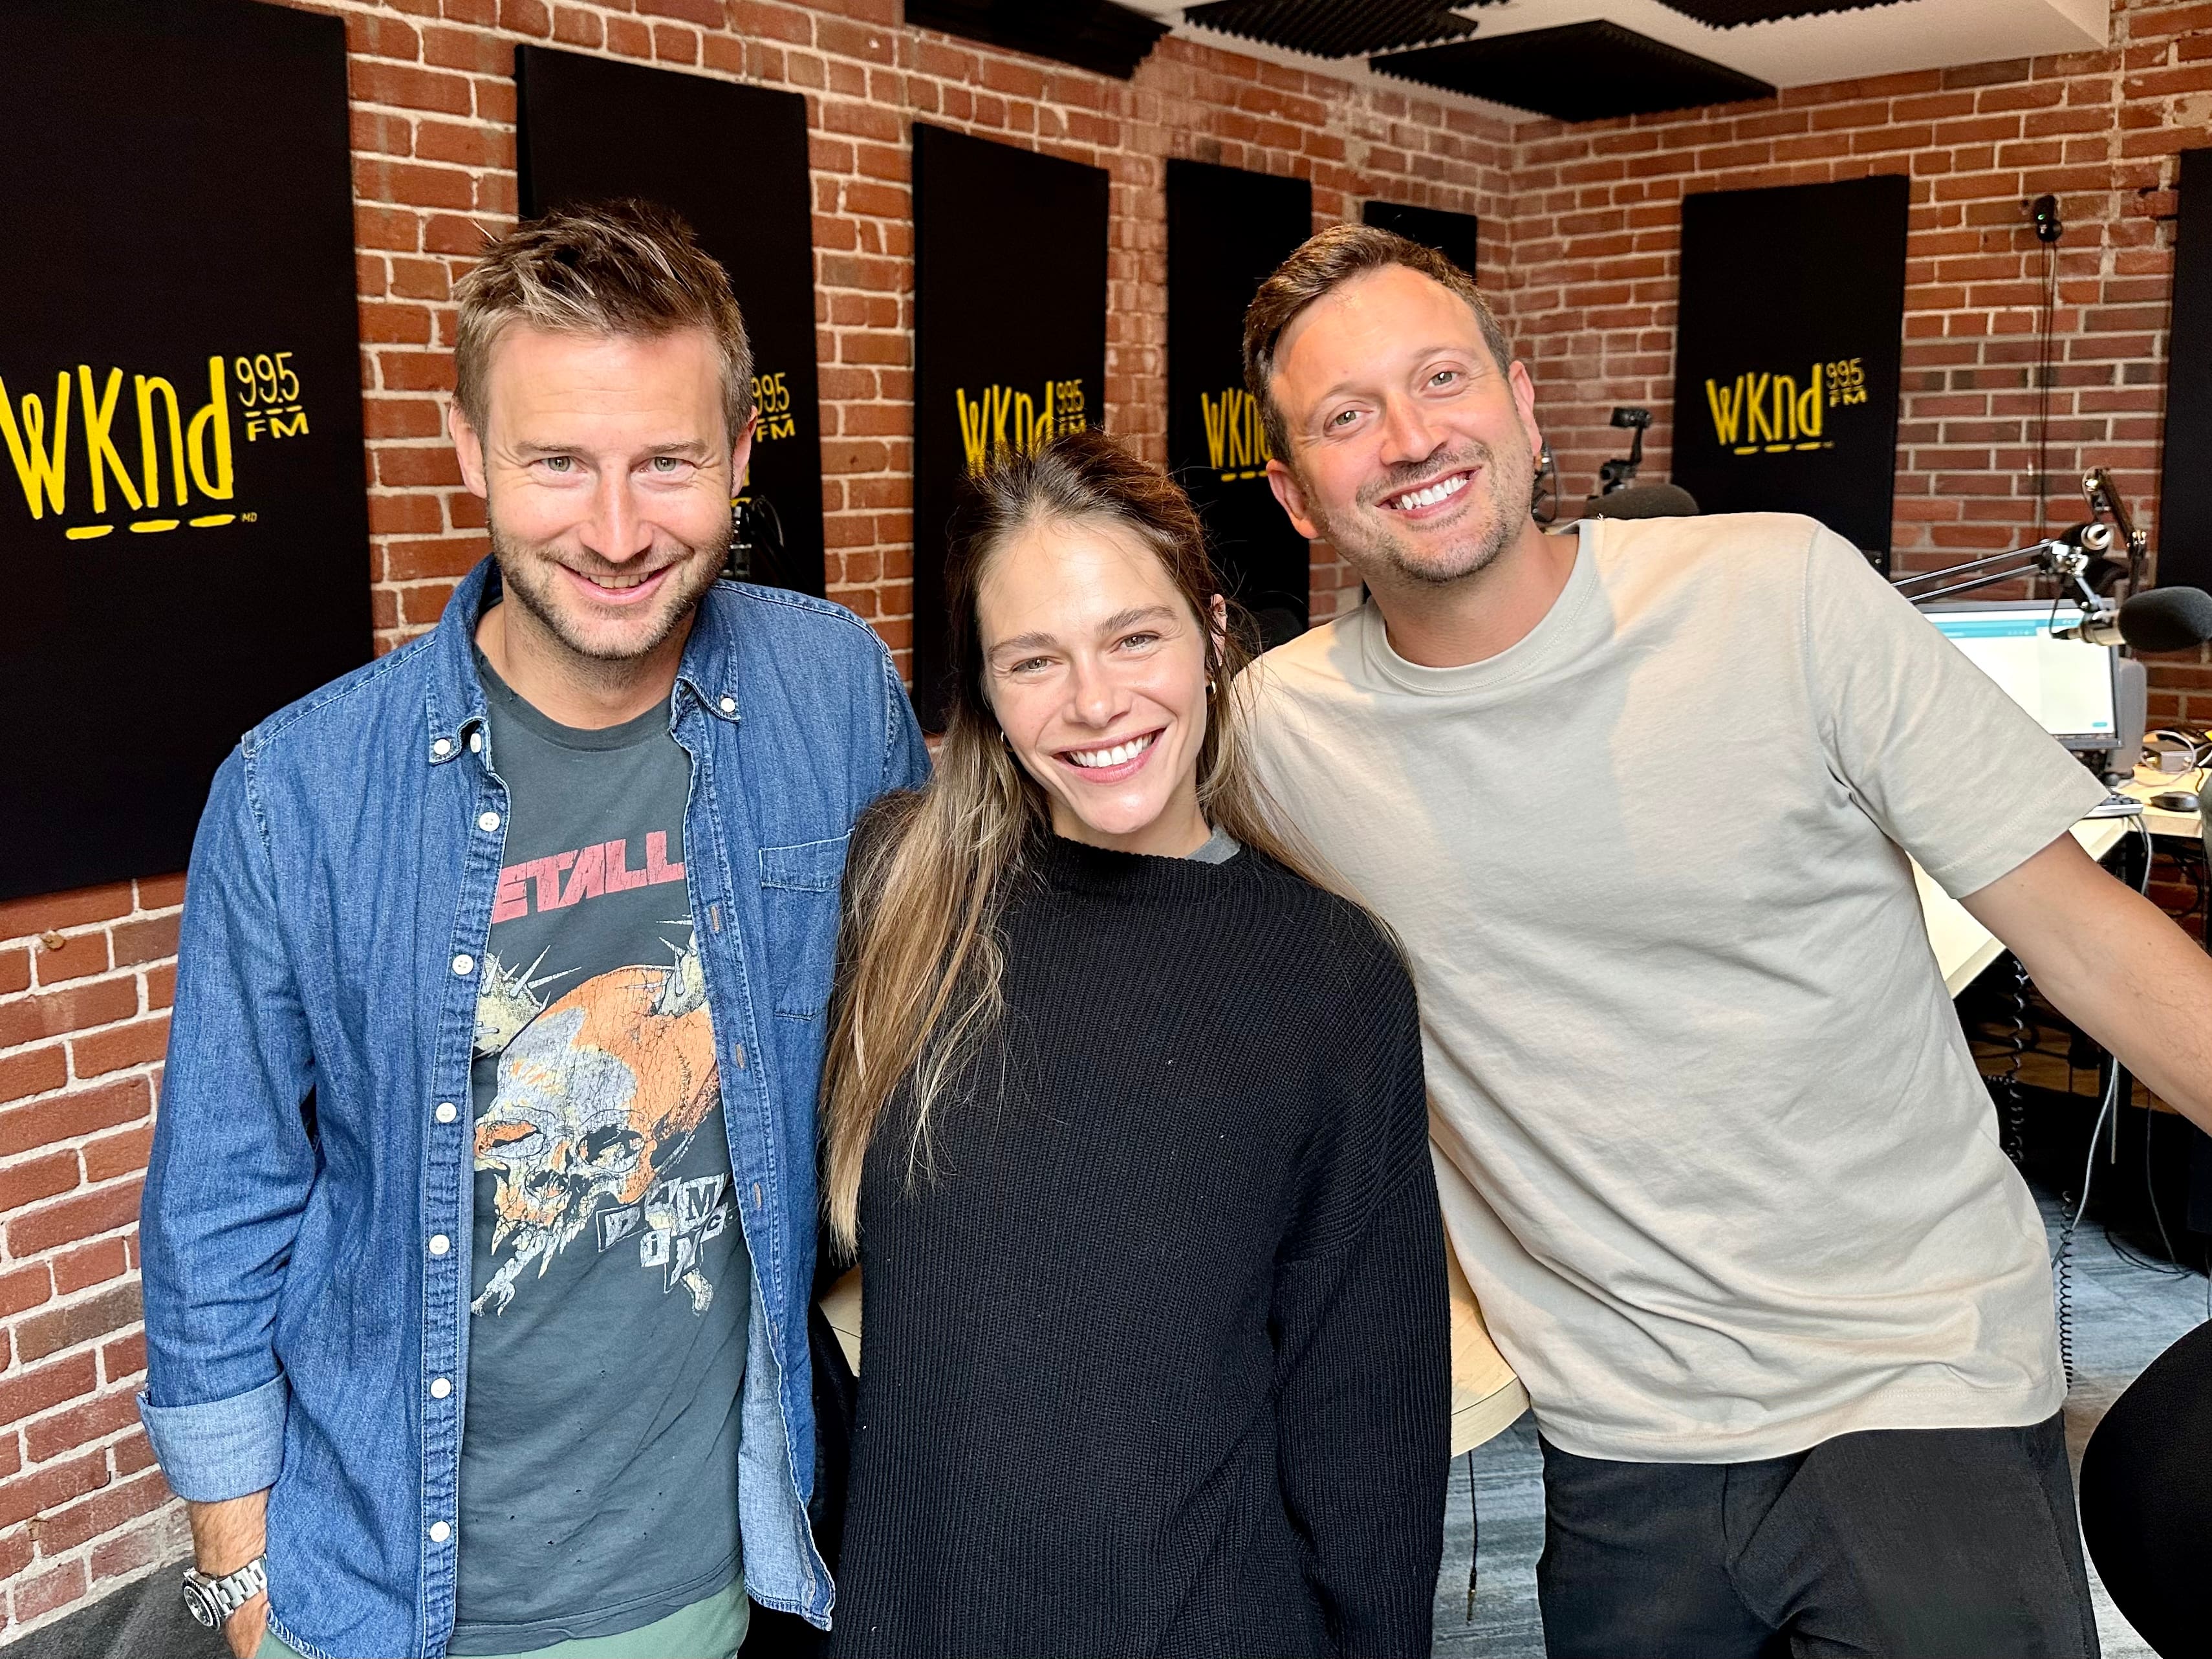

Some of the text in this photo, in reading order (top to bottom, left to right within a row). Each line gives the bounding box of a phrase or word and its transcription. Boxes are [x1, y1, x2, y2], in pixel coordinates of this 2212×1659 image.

[235, 351, 300, 407] 99.5
[1829, 390, 1869, 408] FM
[248, 412, 310, 442] FM
[756, 419, 796, 442] FM
